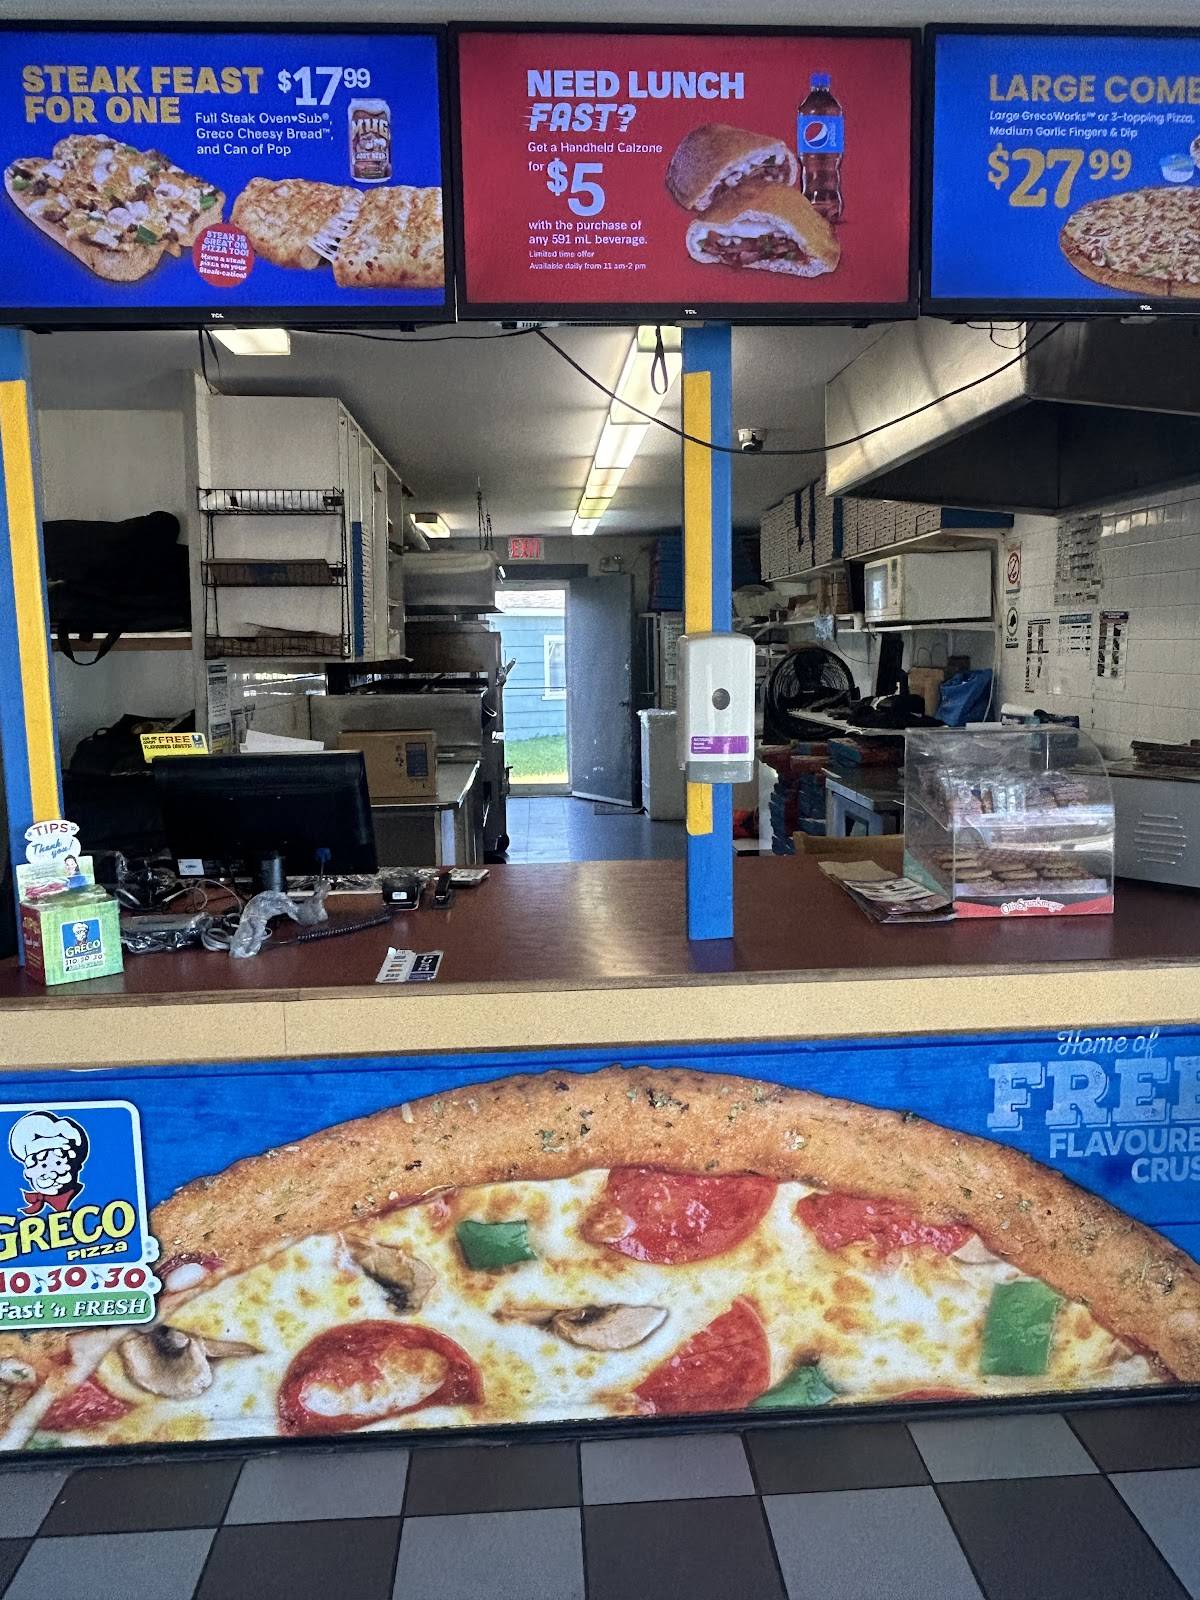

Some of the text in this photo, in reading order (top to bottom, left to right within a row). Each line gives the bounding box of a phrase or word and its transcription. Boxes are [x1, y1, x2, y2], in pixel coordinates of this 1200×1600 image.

[22, 64, 264, 94] STEAK FEAST
[527, 69, 745, 100] NEED LUNCH
[989, 74, 1096, 103] LARGE
[24, 95, 181, 124] FOR ONE
[989, 110, 1019, 123] Large
[195, 112, 217, 124] Full
[220, 113, 256, 124] Steak
[527, 102, 637, 132] FAST?
[196, 128, 234, 139] Greco
[237, 128, 283, 142] Cheesy
[352, 118, 389, 140] MUG
[989, 126, 1138, 140] Medium Garlic Fingers & Dip
[197, 144, 291, 156] and Can of Pop
[528, 141, 663, 153] Get a Handheld Calzone
[528, 157, 606, 217] for $5
[528, 220, 642, 232] with the purchase of
[204, 236, 233, 248] GREAT
[206, 230, 235, 241] STEAK
[528, 234, 648, 247] any 591 mL beverage.
[201, 243, 228, 254] PIZZA
[529, 250, 595, 258] Limited time offer
[529, 262, 564, 270] Available
[565, 262, 583, 271] daily
[584, 262, 602, 270] from
[603, 262, 612, 270] 11
[634, 263, 646, 271] pm
[511, 539, 540, 558] EXIT
[158, 735, 190, 743] FREE
[33, 823, 68, 836] TIPS
[32, 838, 61, 855] Thank
[65, 939, 101, 958] GRECO
[1057, 1026, 1160, 1060] Home of
[0, 1200, 136, 1262] GRECO
[47, 1266, 87, 1293] 30
[104, 1267, 147, 1290] 30
[0, 1300, 44, 1320] Fast
[73, 1297, 148, 1317] FRESH
